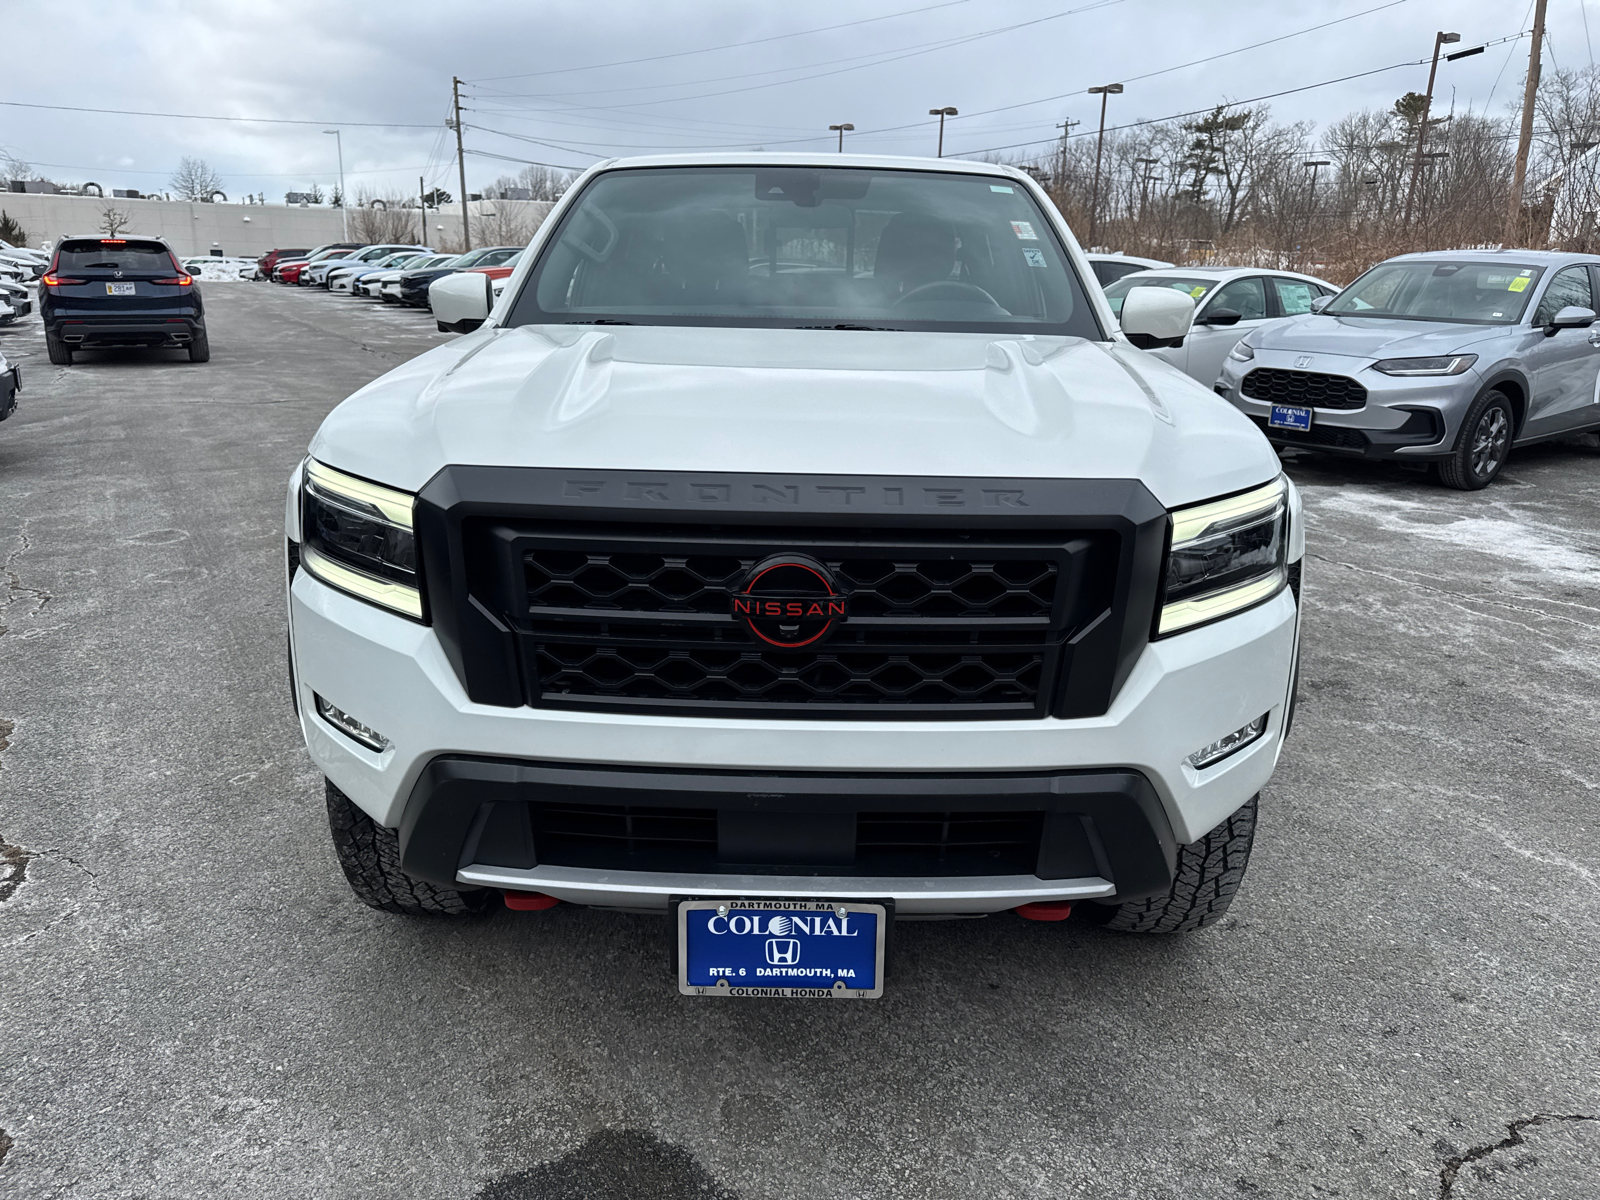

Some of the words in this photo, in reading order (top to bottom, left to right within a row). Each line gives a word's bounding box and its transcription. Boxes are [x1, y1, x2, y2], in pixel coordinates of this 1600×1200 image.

[1275, 407, 1307, 416] COLONIAL
[563, 479, 1031, 508] FRONTIER
[734, 598, 845, 616] NISSAN
[730, 901, 812, 911] DARTMOUTH,
[815, 903, 834, 911] MA
[707, 915, 859, 937] COLONIAL
[709, 967, 736, 977] RTE.
[739, 968, 747, 977] 6
[756, 968, 835, 978] DARTMOUTH,
[838, 969, 856, 978] MA
[729, 987, 788, 997] COLONIAL
[790, 989, 833, 998] HONDA
